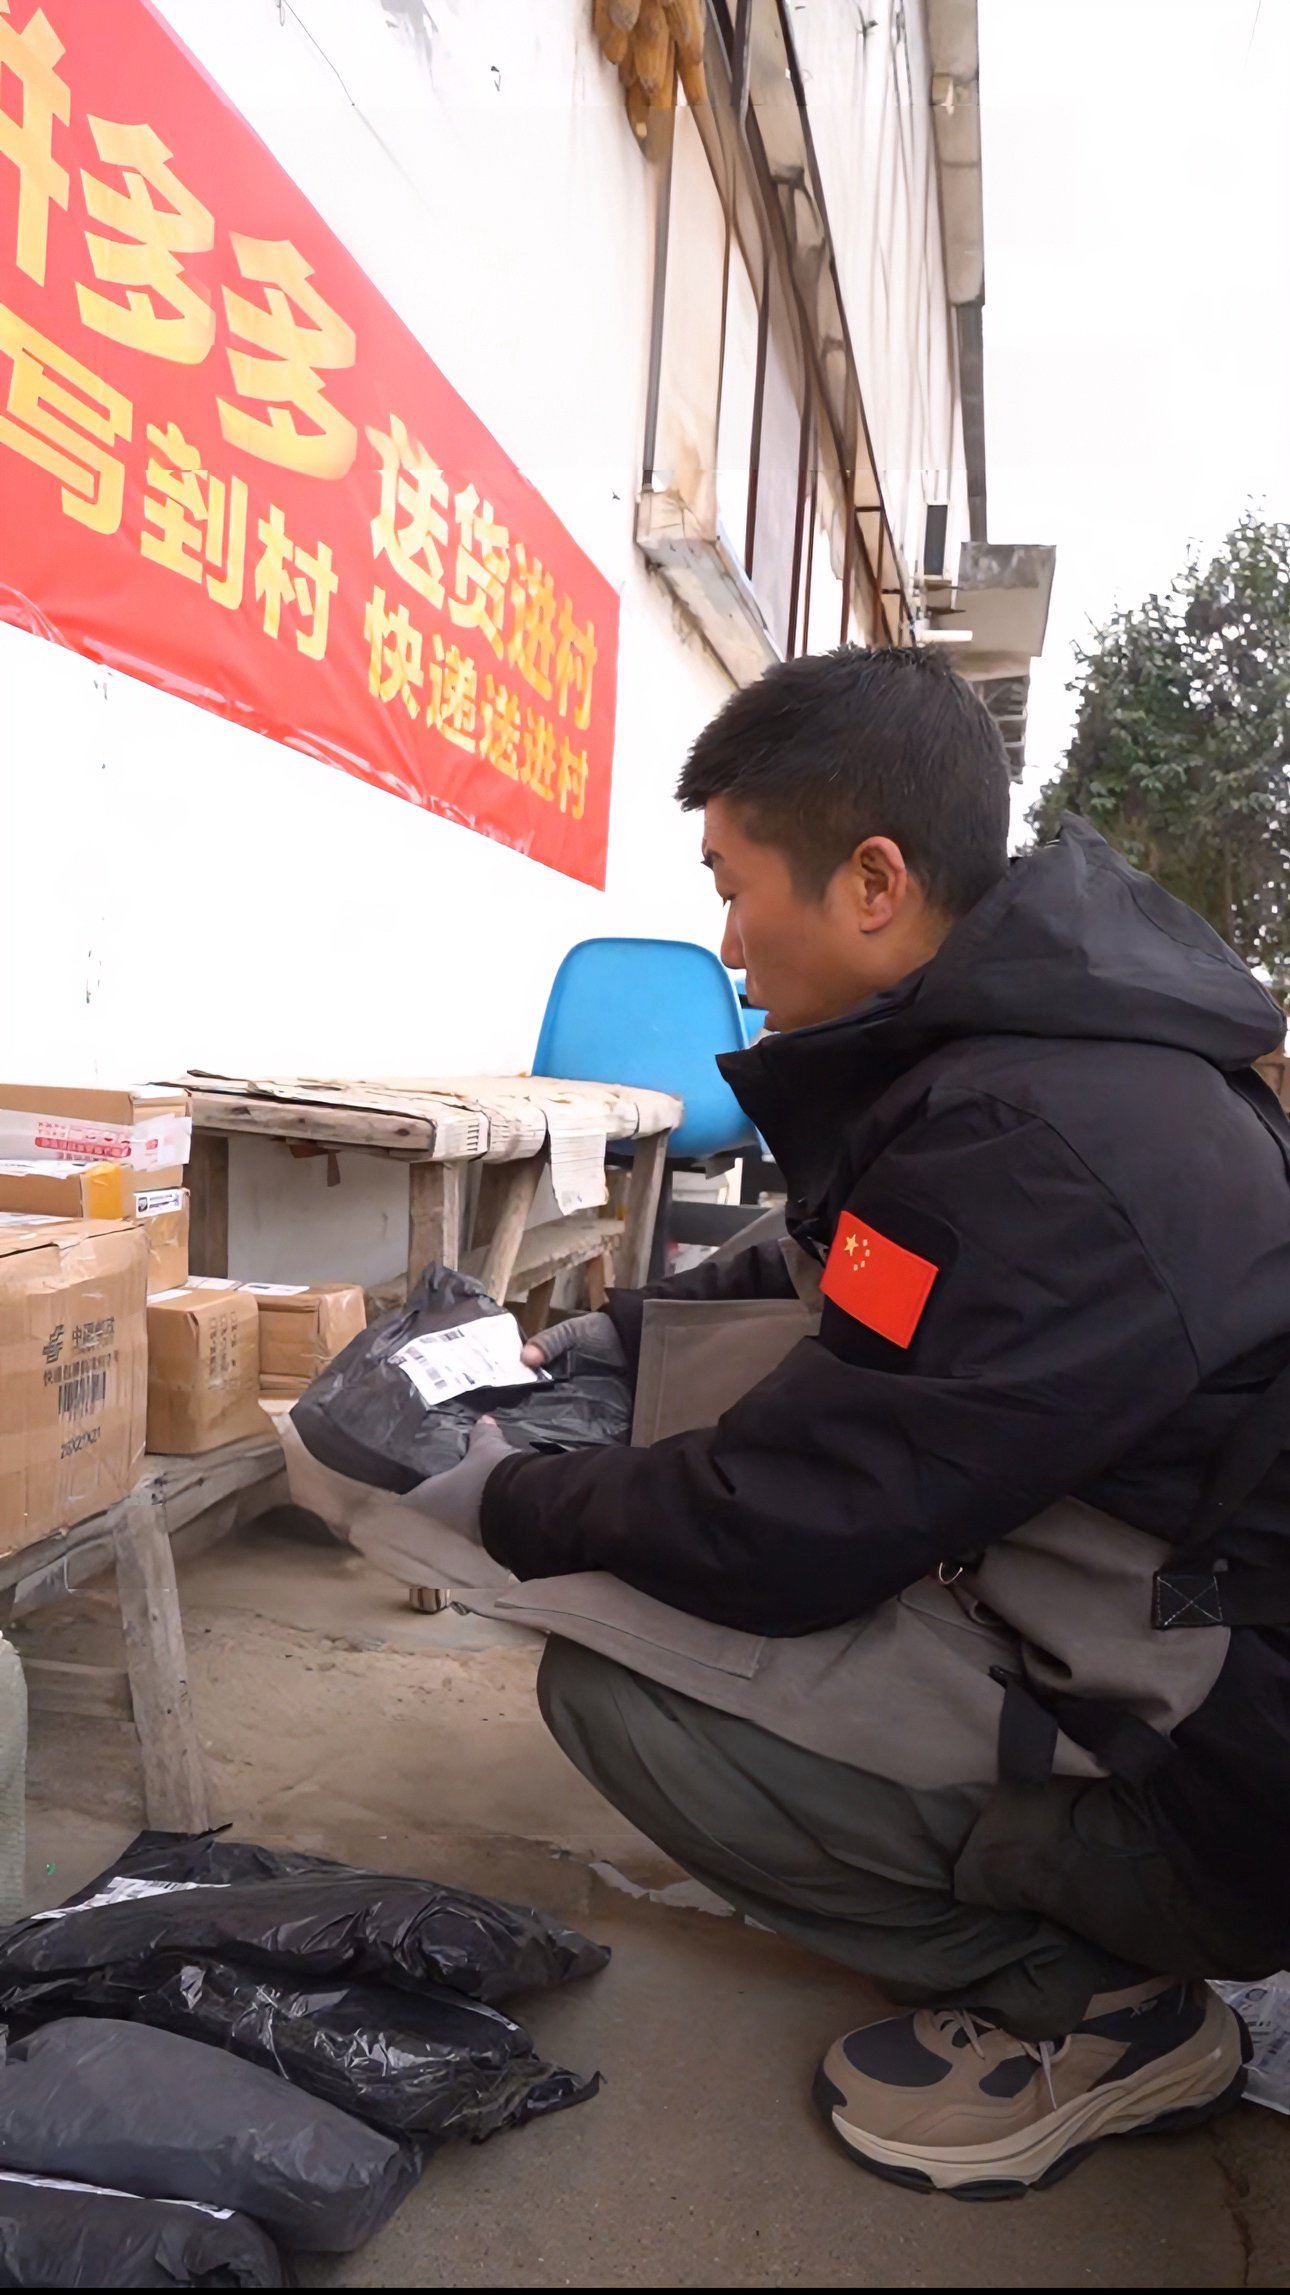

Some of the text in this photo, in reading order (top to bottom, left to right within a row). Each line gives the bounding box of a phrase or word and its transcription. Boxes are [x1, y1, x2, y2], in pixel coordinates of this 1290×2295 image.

[364, 585, 589, 820] 快递送进村
[366, 413, 597, 730] 送货进村
